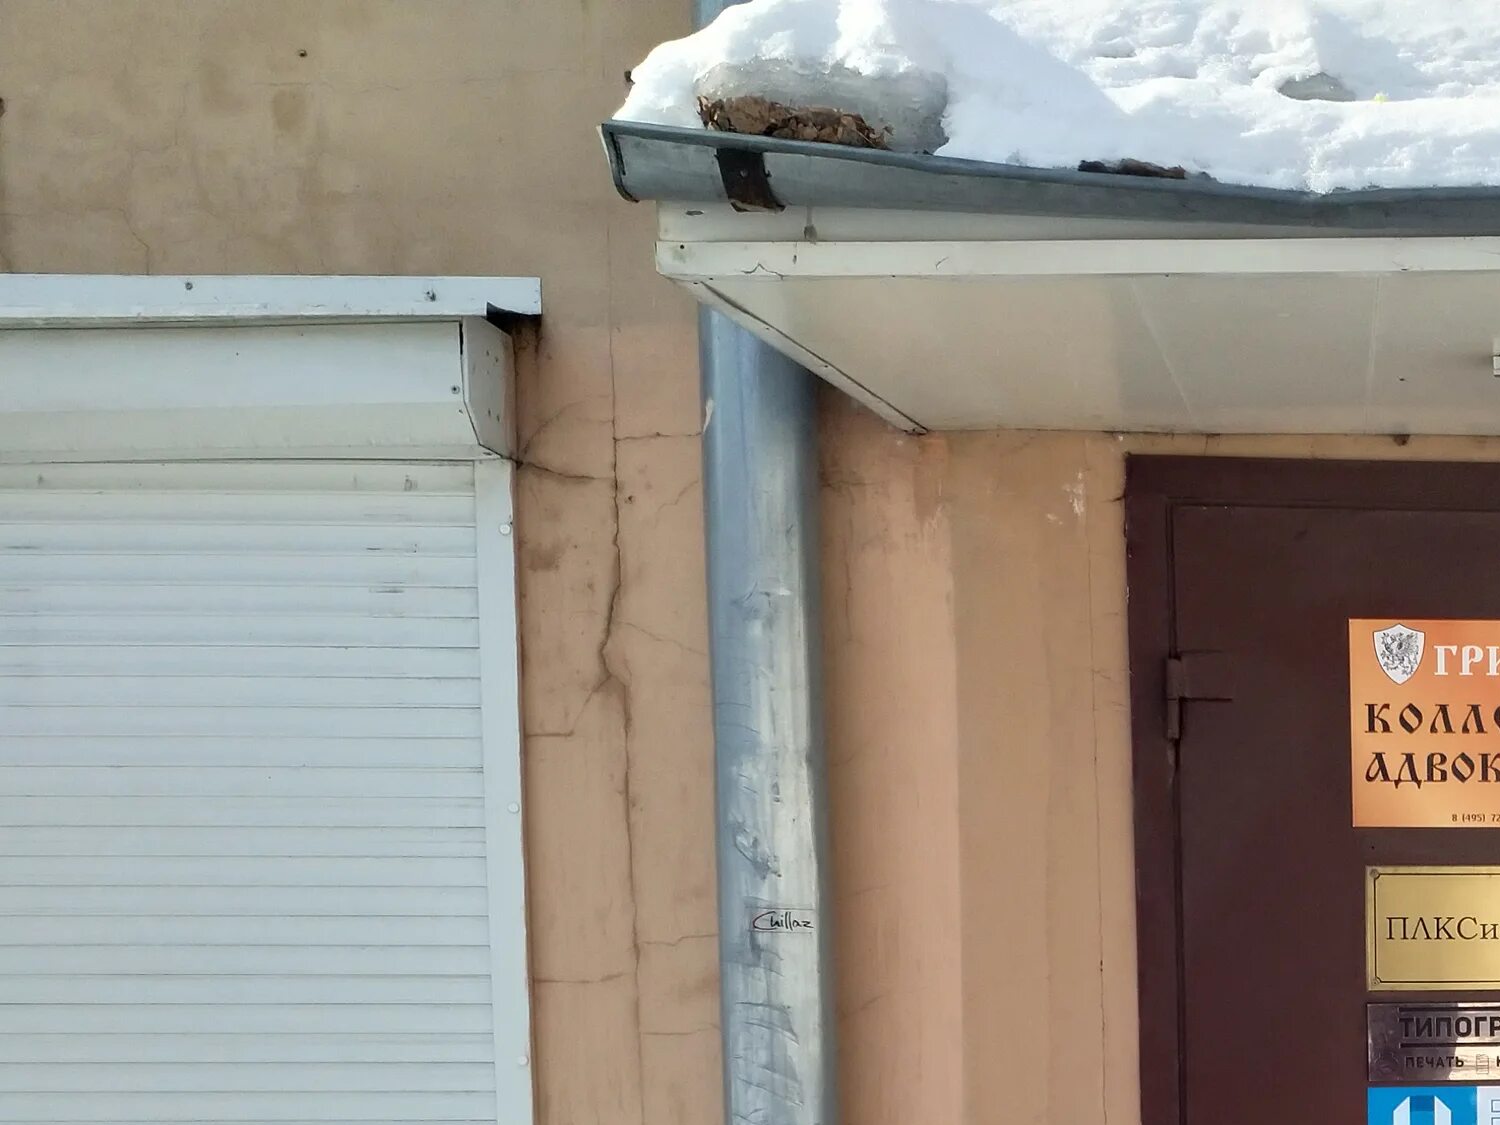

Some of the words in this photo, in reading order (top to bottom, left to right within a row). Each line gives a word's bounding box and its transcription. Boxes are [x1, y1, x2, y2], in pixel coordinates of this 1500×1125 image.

[1451, 813, 1458, 823] 8
[1461, 813, 1486, 823] (495)
[1405, 1055, 1464, 1069] ПЕЧАТЬ
